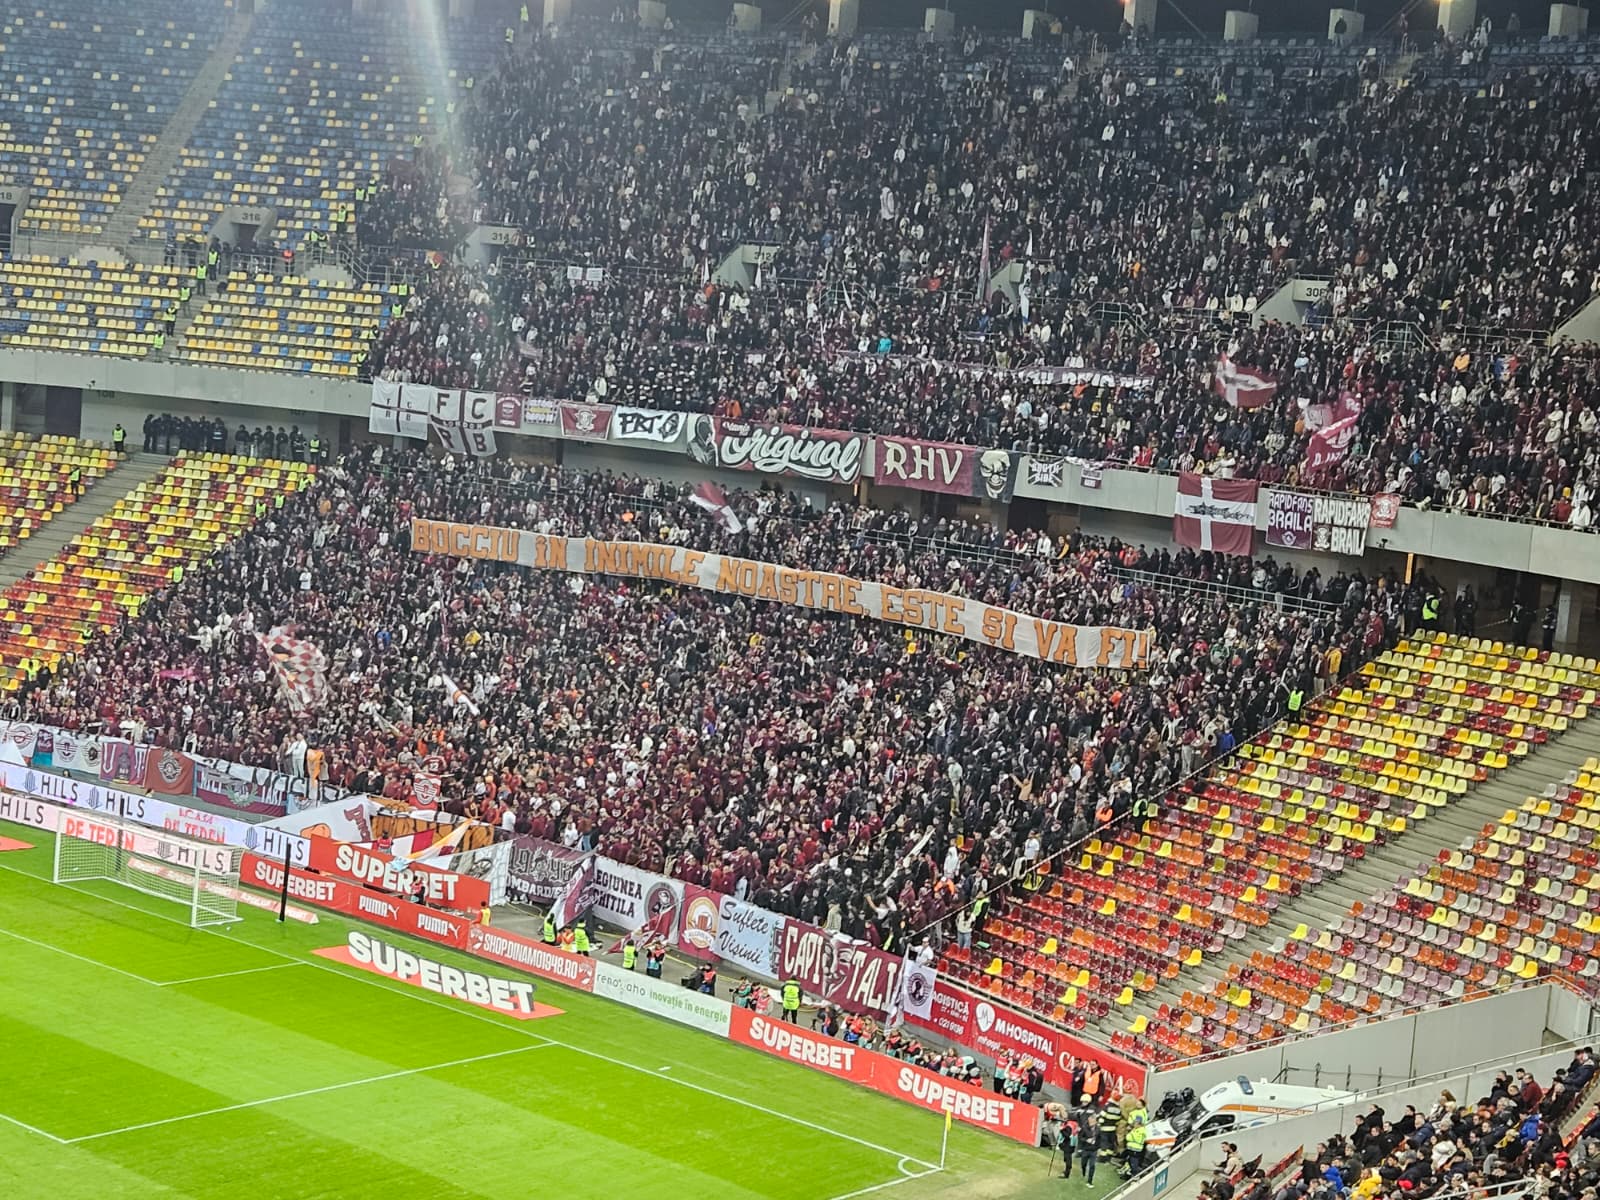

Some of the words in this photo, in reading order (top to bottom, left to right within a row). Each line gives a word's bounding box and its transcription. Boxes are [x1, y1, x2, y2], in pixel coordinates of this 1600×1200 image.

[437, 392, 450, 414] F
[472, 397, 487, 419] C
[472, 432, 487, 452] B
[884, 439, 963, 484] RHV
[1268, 509, 1313, 533] BRAILA
[412, 519, 520, 562] BOCCIU
[584, 538, 705, 586] INIMILE
[716, 556, 871, 616] NOASTRE,
[880, 584, 966, 635] ESTE
[1034, 619, 1077, 666] VA
[1096, 628, 1148, 669] FI!
[41, 774, 79, 802] HILS
[1, 796, 44, 825] HILS
[106, 790, 145, 819] HLS
[254, 860, 336, 901] SUPERBET
[359, 895, 389, 917] PUMA
[721, 901, 769, 934] Suflete
[417, 913, 449, 935] PUMA
[483, 933, 578, 979] SHOP.DINAMO1948.RO
[348, 931, 535, 1013] SUPERBET
[694, 1006, 728, 1024] energie
[749, 1016, 855, 1070] SUPERBET
[995, 1018, 1054, 1057] MHOSPITAL
[897, 1066, 1014, 1127] SUPERBET
